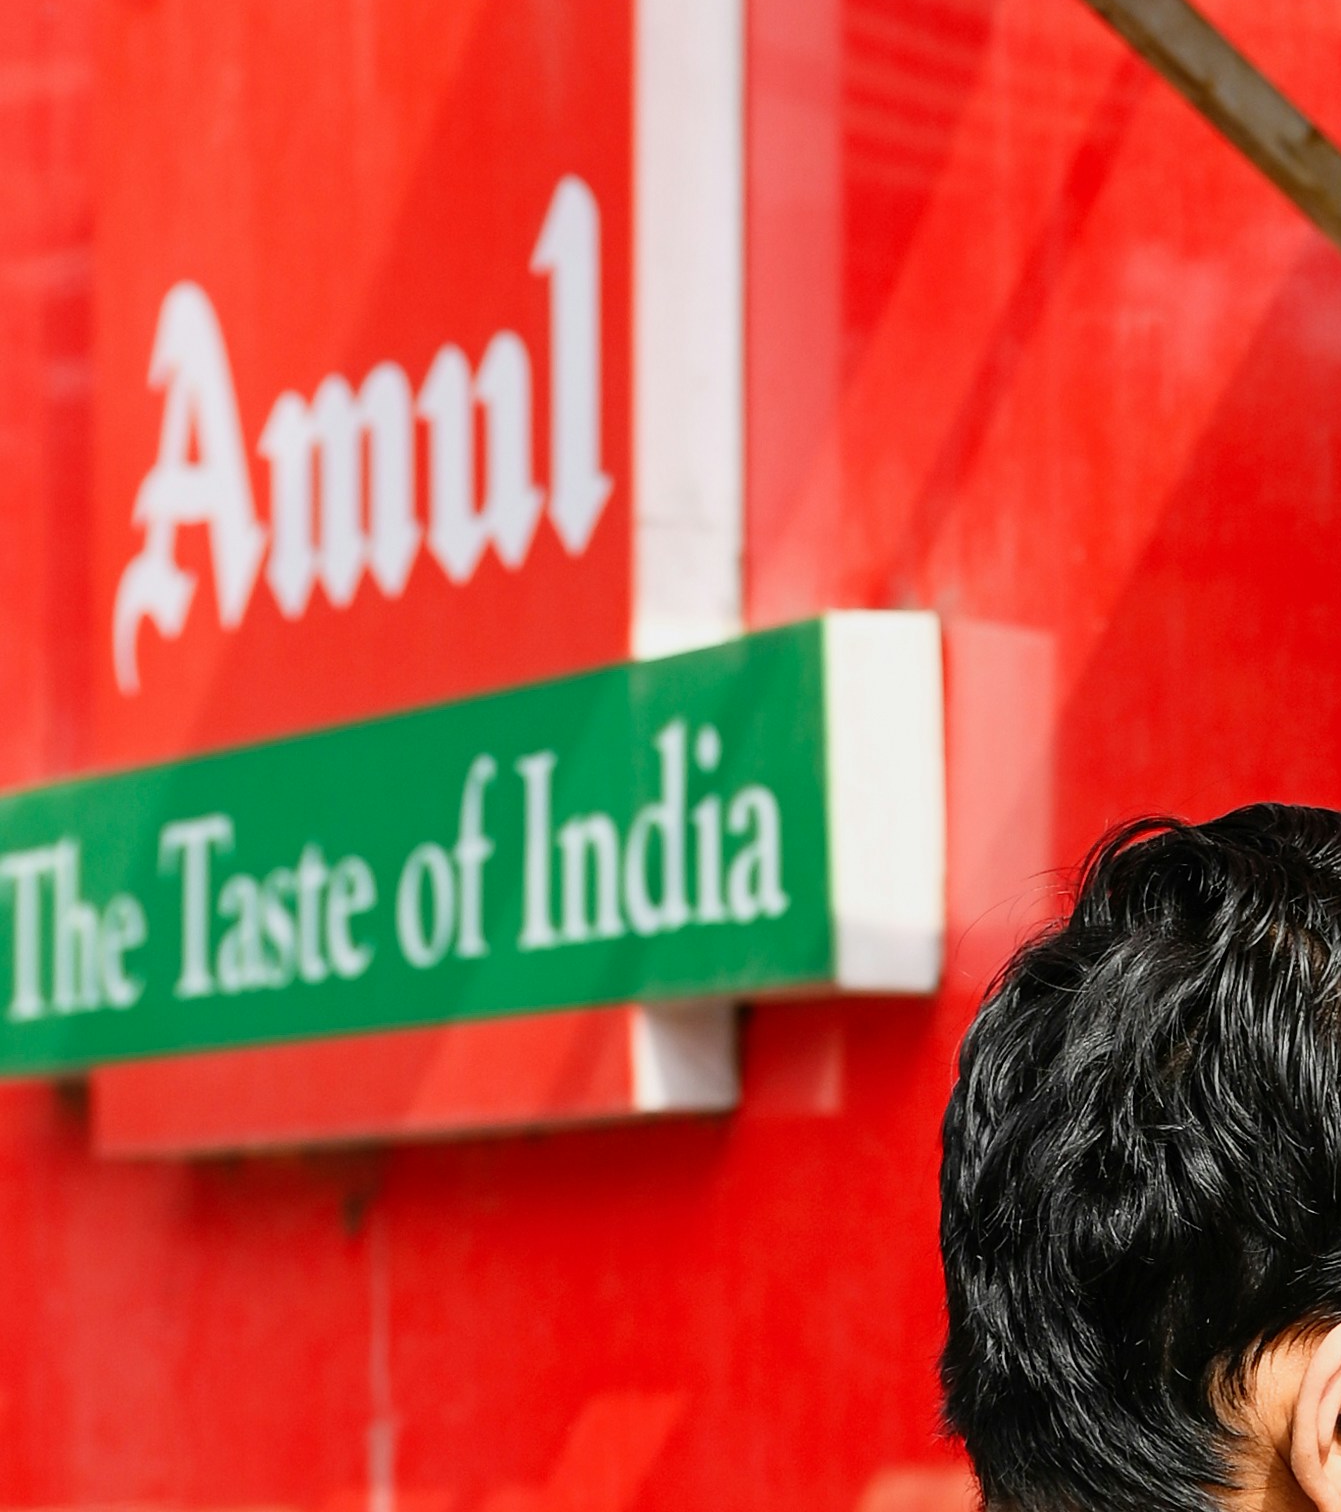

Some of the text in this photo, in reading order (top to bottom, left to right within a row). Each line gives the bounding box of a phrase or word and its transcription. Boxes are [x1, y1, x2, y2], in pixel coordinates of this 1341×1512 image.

[113, 174, 613, 695] Amul
[0, 719, 789, 1022] The Taste of India
